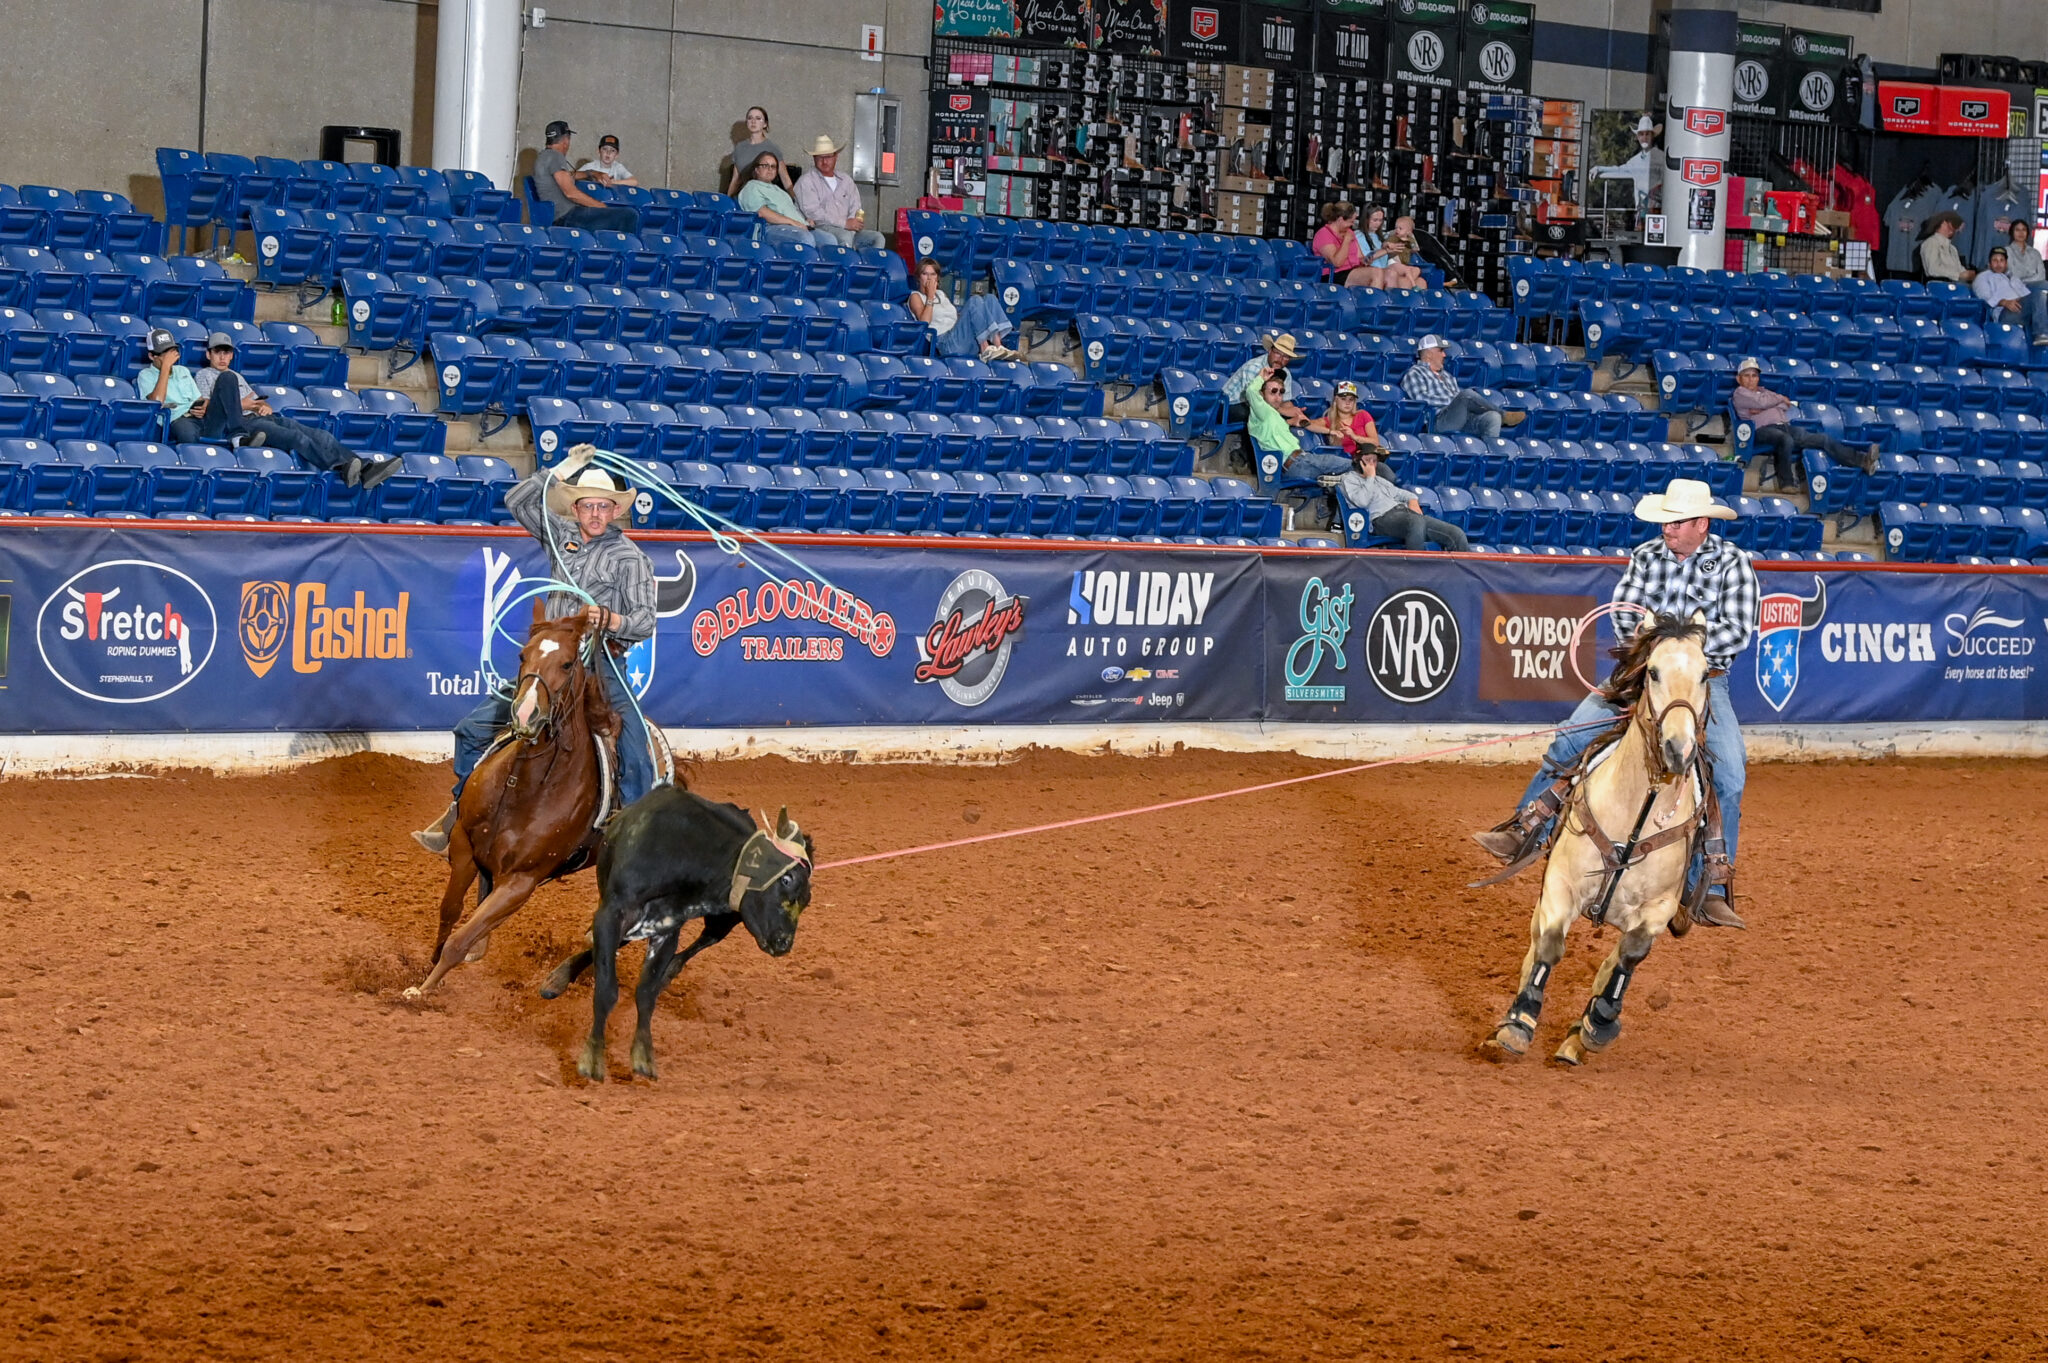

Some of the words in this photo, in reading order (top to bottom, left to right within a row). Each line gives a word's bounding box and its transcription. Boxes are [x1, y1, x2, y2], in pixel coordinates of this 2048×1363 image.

[971, 14, 997, 23] BOOTS
[1489, 12, 1528, 25] 800-GO-ROPIN
[1181, 41, 1204, 50] HORSE
[1205, 43, 1228, 51] POWER
[1263, 23, 1276, 50] TOP
[1277, 25, 1295, 53] HAND
[1336, 31, 1349, 57] TOP
[1351, 33, 1369, 60] HAND
[1414, 35, 1438, 67] NRS
[1485, 46, 1510, 77] NRS
[1396, 70, 1452, 87] NRSworld.com
[1738, 65, 1762, 96] NRS
[1805, 76, 1829, 106] NRS
[1733, 102, 1776, 115] Sworld.com
[932, 158, 945, 169] WIN
[941, 575, 1002, 616] GENUINE
[1067, 570, 1215, 625] HOLIDAY
[716, 579, 874, 644] BLOOMER
[1763, 602, 1799, 624] USTRC
[292, 582, 410, 674] Cashel
[1284, 576, 1354, 687] Gist
[1493, 615, 1583, 646] COWBOY
[107, 646, 137, 657] ROPING
[139, 646, 177, 657] DUMMIES
[740, 636, 844, 661] TRAILERS
[1066, 637, 1127, 656] AUTO
[1142, 636, 1214, 656] GROUP
[1379, 601, 1447, 688] NRS
[1821, 622, 1936, 663] CINCH
[1155, 669, 1179, 679] GMC
[1511, 650, 1565, 679] TACK
[1944, 666, 1964, 683] Every
[1965, 665, 1985, 679] horse
[1986, 667, 1996, 679] at
[1997, 665, 2008, 679] its
[144, 675, 153, 683] TX
[426, 671, 480, 696] Total
[1148, 692, 1173, 708] Jeep
[1286, 688, 1345, 700] SILVERSMITHS
